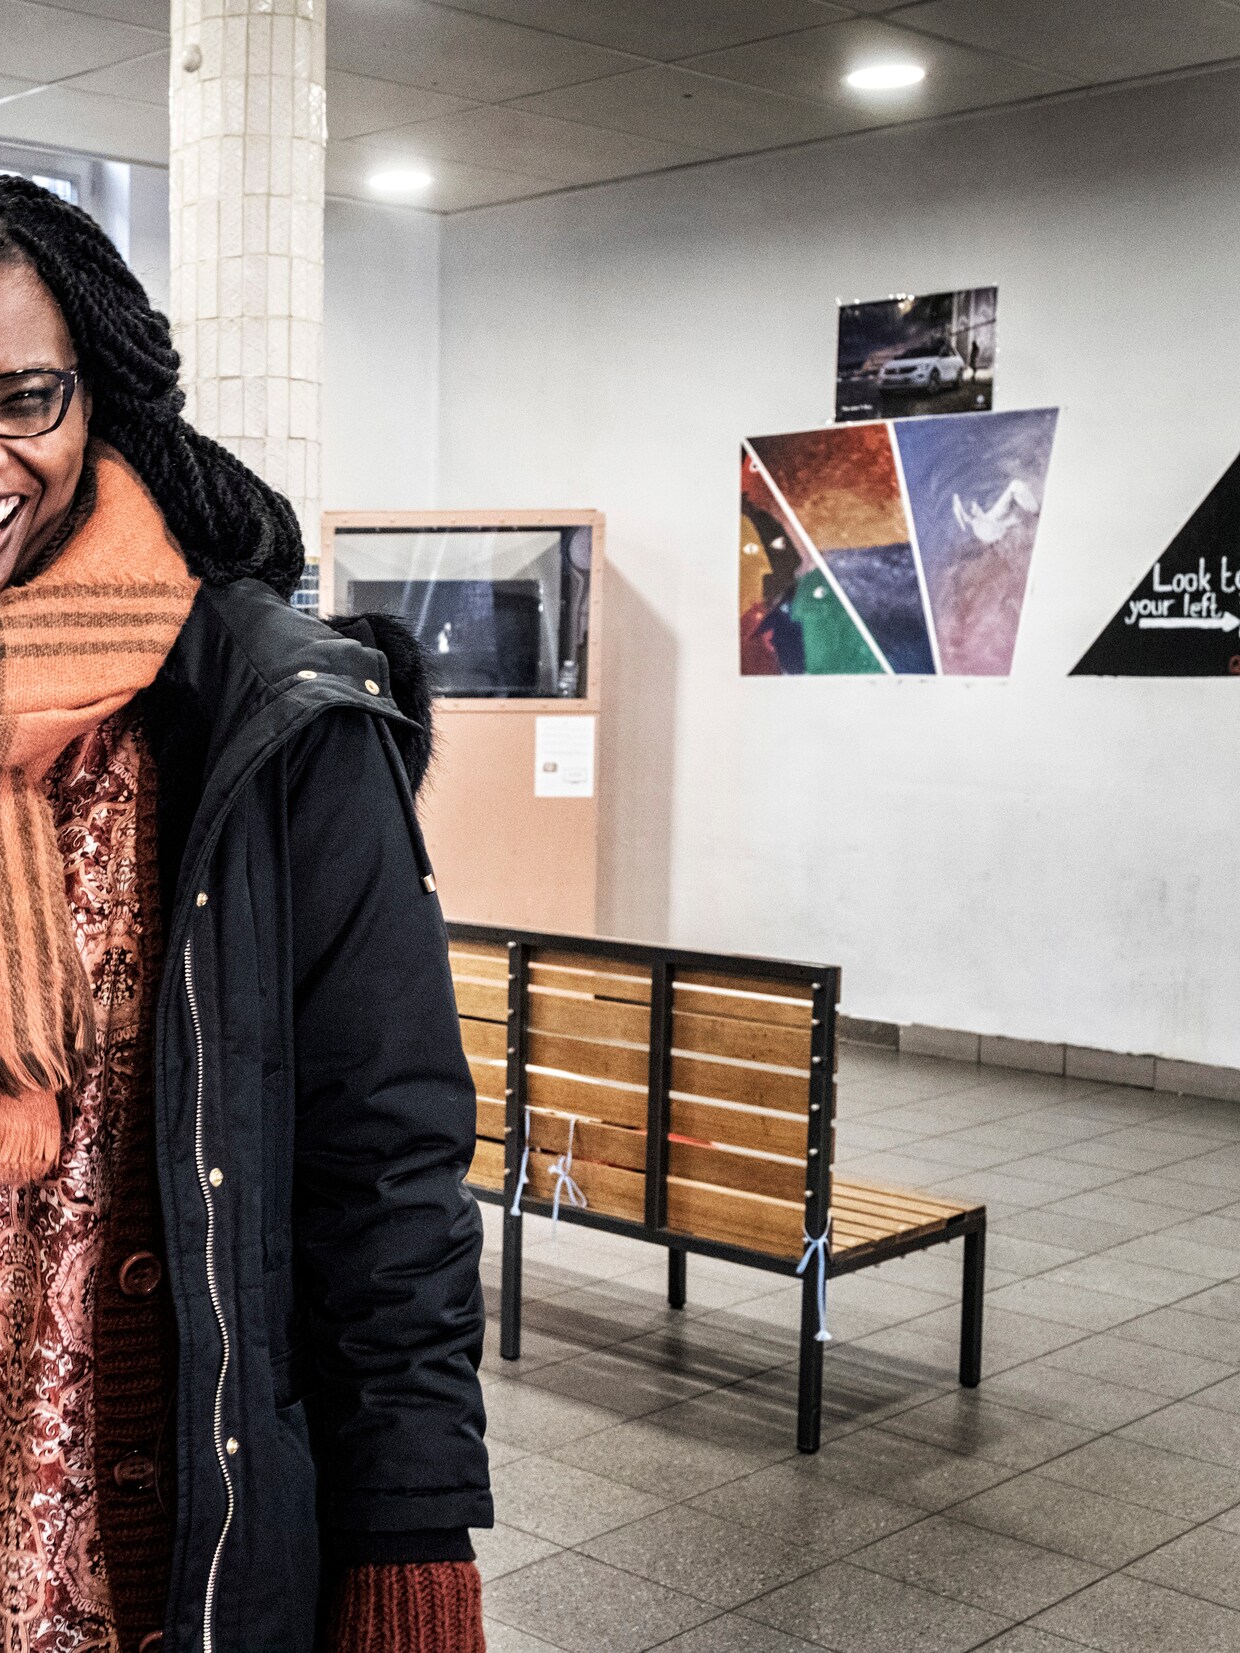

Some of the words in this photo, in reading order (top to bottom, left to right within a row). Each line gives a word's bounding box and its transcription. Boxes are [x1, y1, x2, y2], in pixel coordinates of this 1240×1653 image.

[1152, 556, 1212, 593] Look
[1124, 598, 1176, 625] your
[1183, 591, 1223, 619] left
